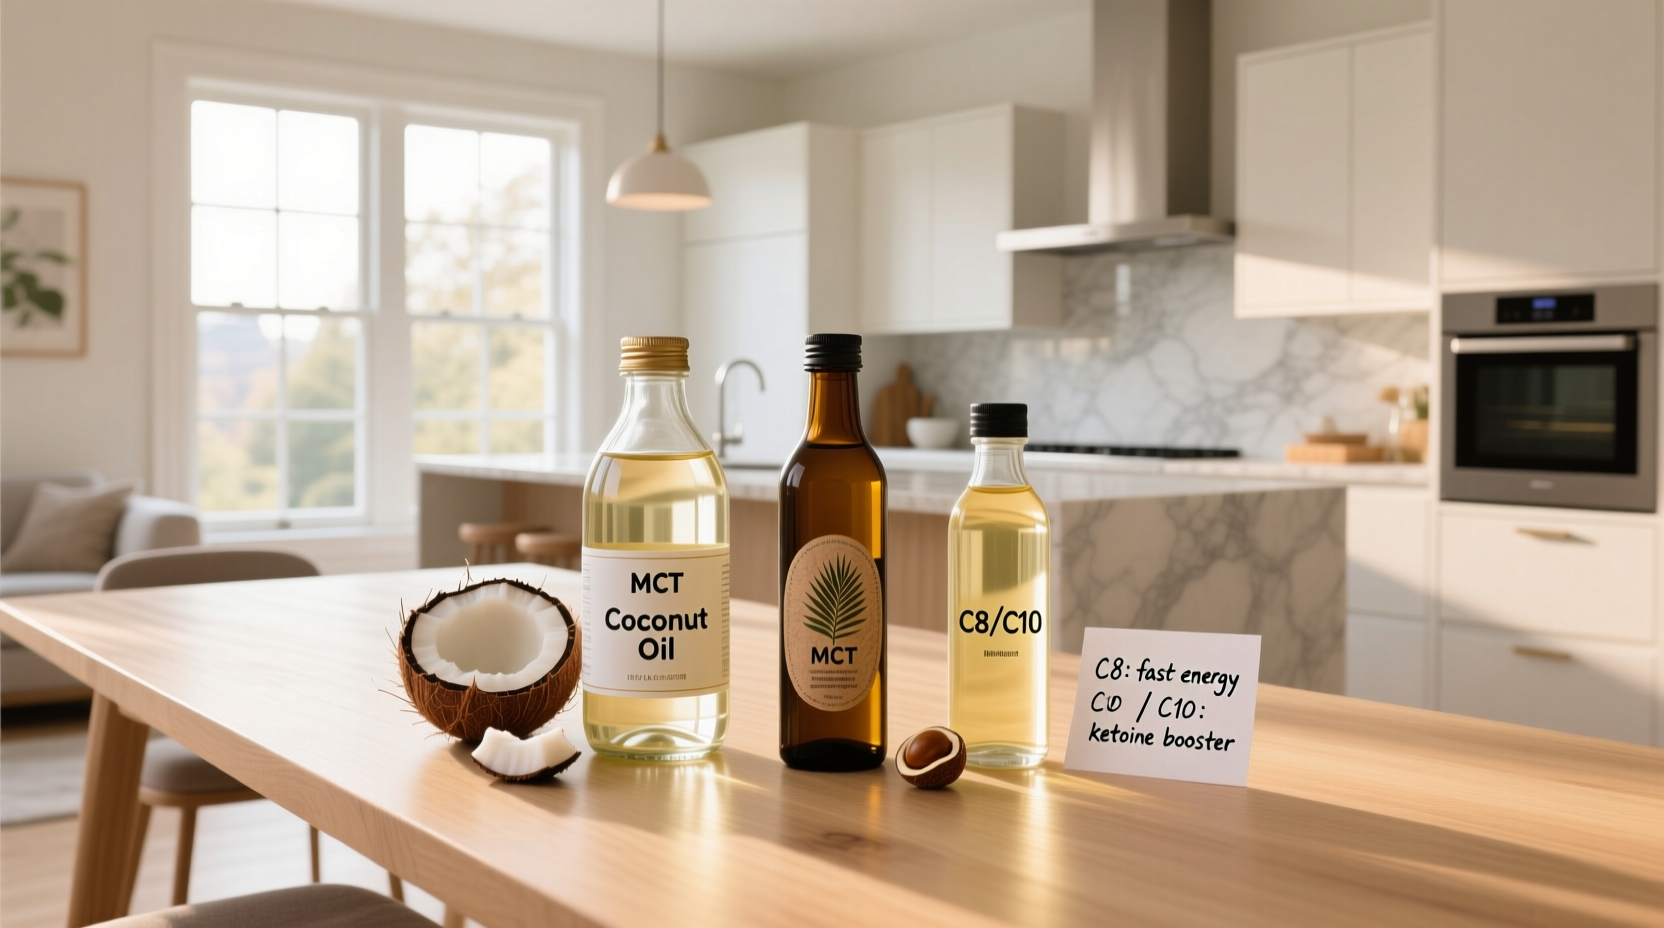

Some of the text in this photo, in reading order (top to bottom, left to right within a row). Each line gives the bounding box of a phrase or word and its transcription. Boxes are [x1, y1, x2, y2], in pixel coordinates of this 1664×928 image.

[631, 572, 684, 594] MCT
[605, 607, 708, 631] Coconut
[959, 605, 1042, 637] C8/C10
[638, 637, 674, 660] Oil
[811, 646, 858, 665] MCT
[1095, 657, 1240, 698] C8: fast energy
[1088, 722, 1235, 752] ketoine booster
